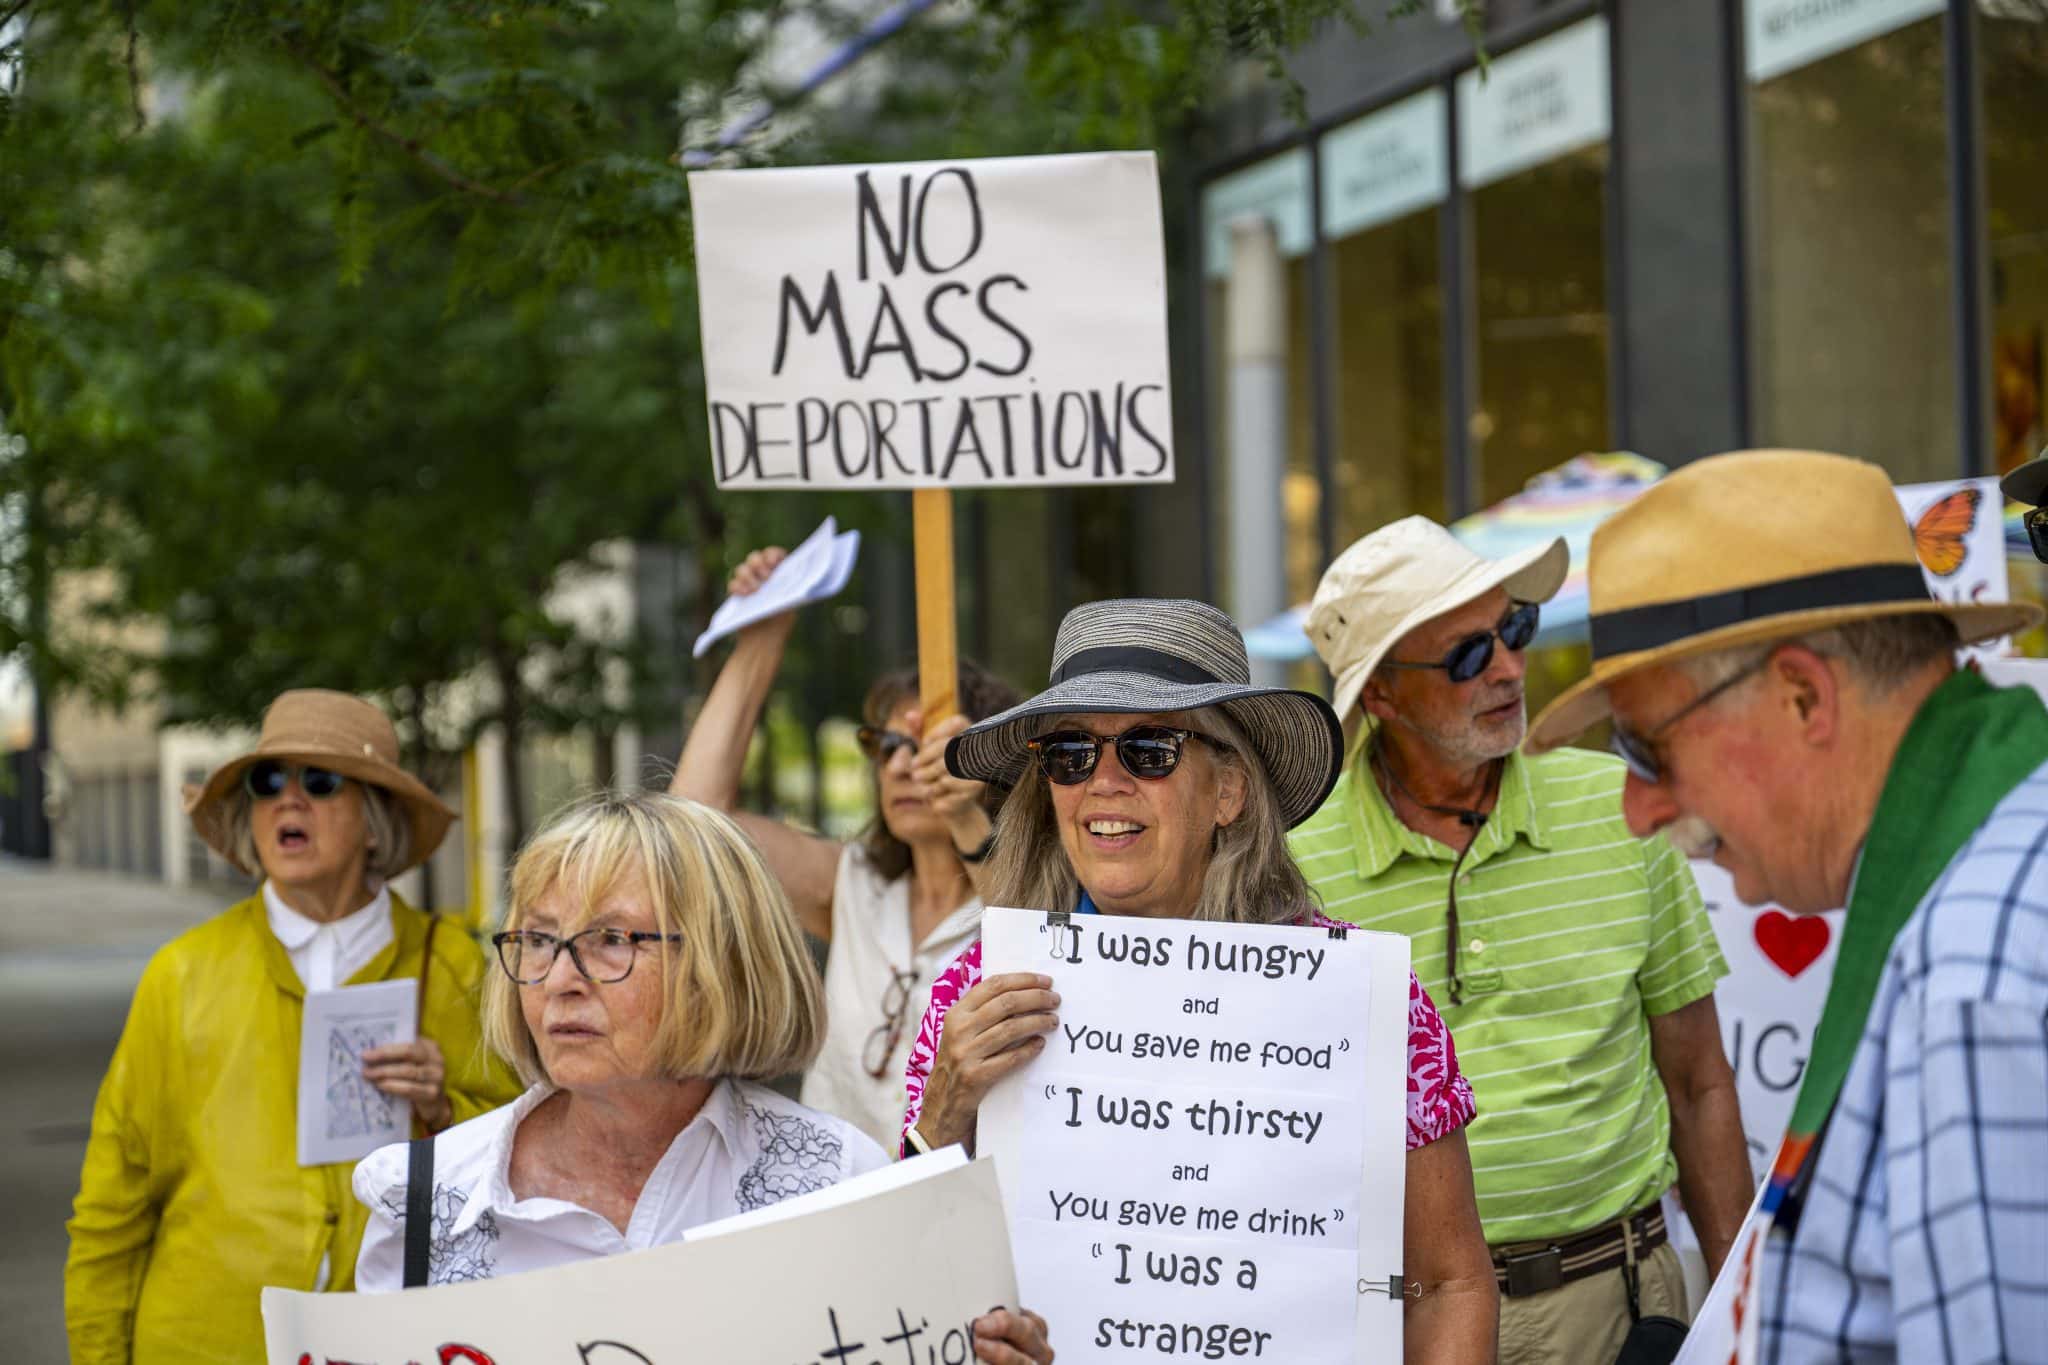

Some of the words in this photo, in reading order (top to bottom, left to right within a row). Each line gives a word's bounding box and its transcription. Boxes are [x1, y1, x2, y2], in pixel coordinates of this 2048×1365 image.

[856, 167, 984, 281] NO
[772, 269, 1032, 383] MASS
[712, 381, 1168, 483] DEPORTATIONS
[1098, 932, 1172, 966] was
[1188, 935, 1324, 980] hungry
[1183, 998, 1219, 1015] and
[1064, 1024, 1122, 1053] You
[1132, 1033, 1199, 1058] gave
[1210, 1040, 1251, 1063] me
[1097, 1095, 1172, 1130] was
[1185, 1099, 1322, 1144] thirsty
[1172, 1164, 1208, 1181] and
[1049, 1190, 1108, 1221] You
[1118, 1200, 1186, 1226] gave
[1197, 1207, 1238, 1230] me
[1146, 1251, 1222, 1286] was
[1237, 1260, 1257, 1290] a
[1095, 1318, 1272, 1360] stranger
